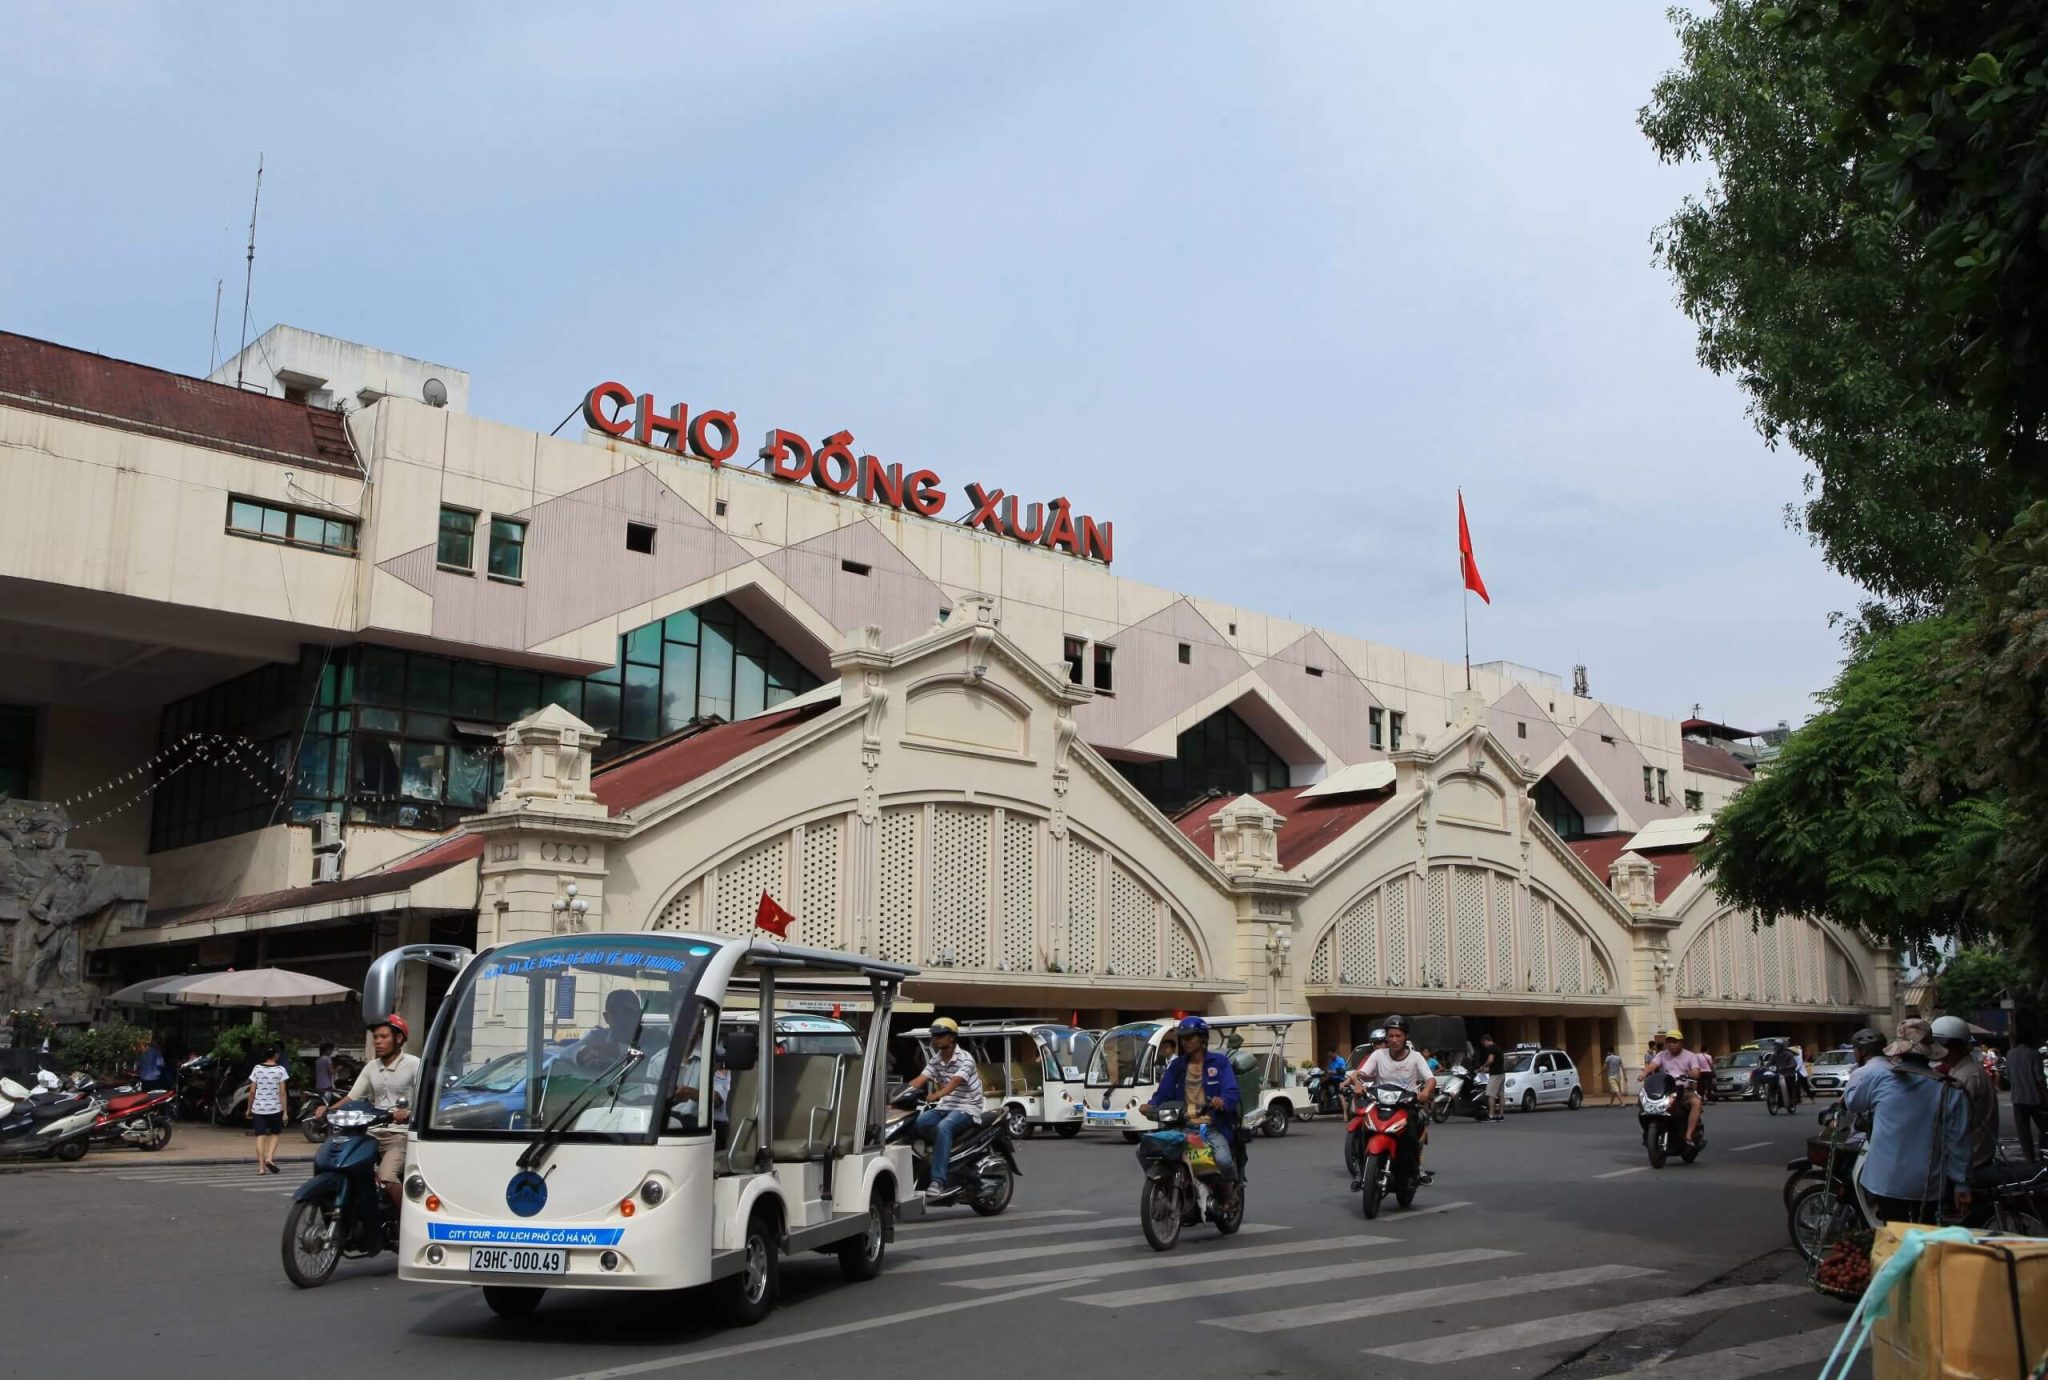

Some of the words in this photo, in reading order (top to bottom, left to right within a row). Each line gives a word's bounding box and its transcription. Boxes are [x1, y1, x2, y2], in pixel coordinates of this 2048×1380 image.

[583, 381, 739, 469] CHỢ
[964, 482, 1113, 563] XUÂN
[524, 957, 537, 972] XE
[448, 1230, 467, 1239] CITY
[468, 1230, 491, 1239] TOUR
[496, 1231, 509, 1240] DU
[510, 1231, 530, 1243] LỊCH
[531, 1230, 552, 1242] PHỐ
[566, 1231, 579, 1243] HÀ
[580, 1232, 597, 1245] NỘI
